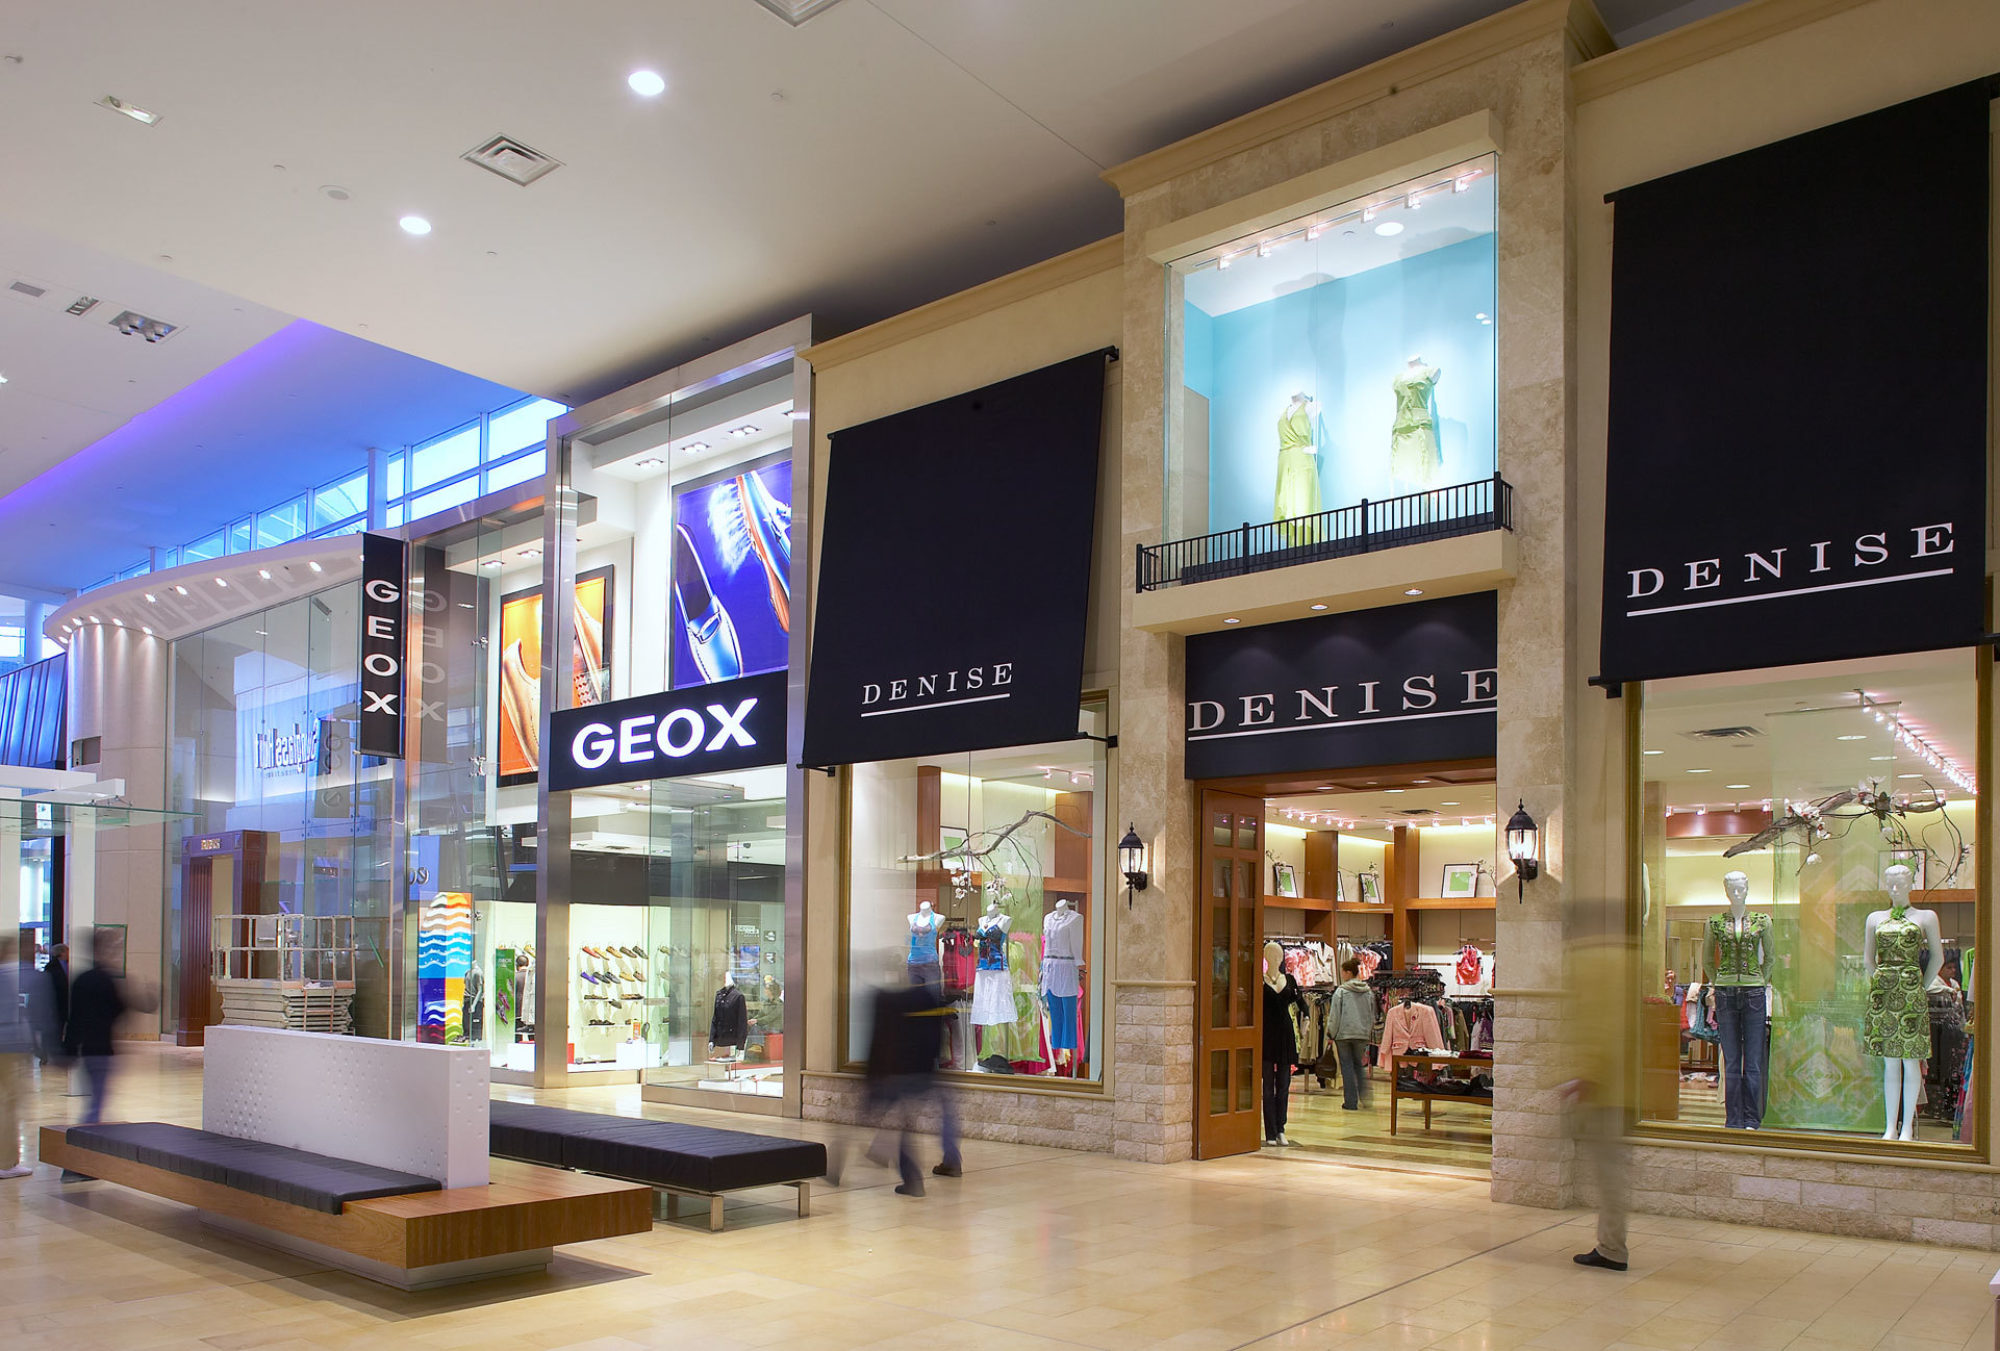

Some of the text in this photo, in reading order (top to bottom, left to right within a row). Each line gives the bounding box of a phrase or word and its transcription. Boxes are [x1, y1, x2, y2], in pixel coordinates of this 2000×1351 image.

[1626, 522, 1954, 599] DENISE
[364, 579, 400, 716] GEOX
[861, 662, 1013, 705] DENISE
[1188, 668, 1497, 732] DENISE
[572, 698, 758, 769] GEOX
